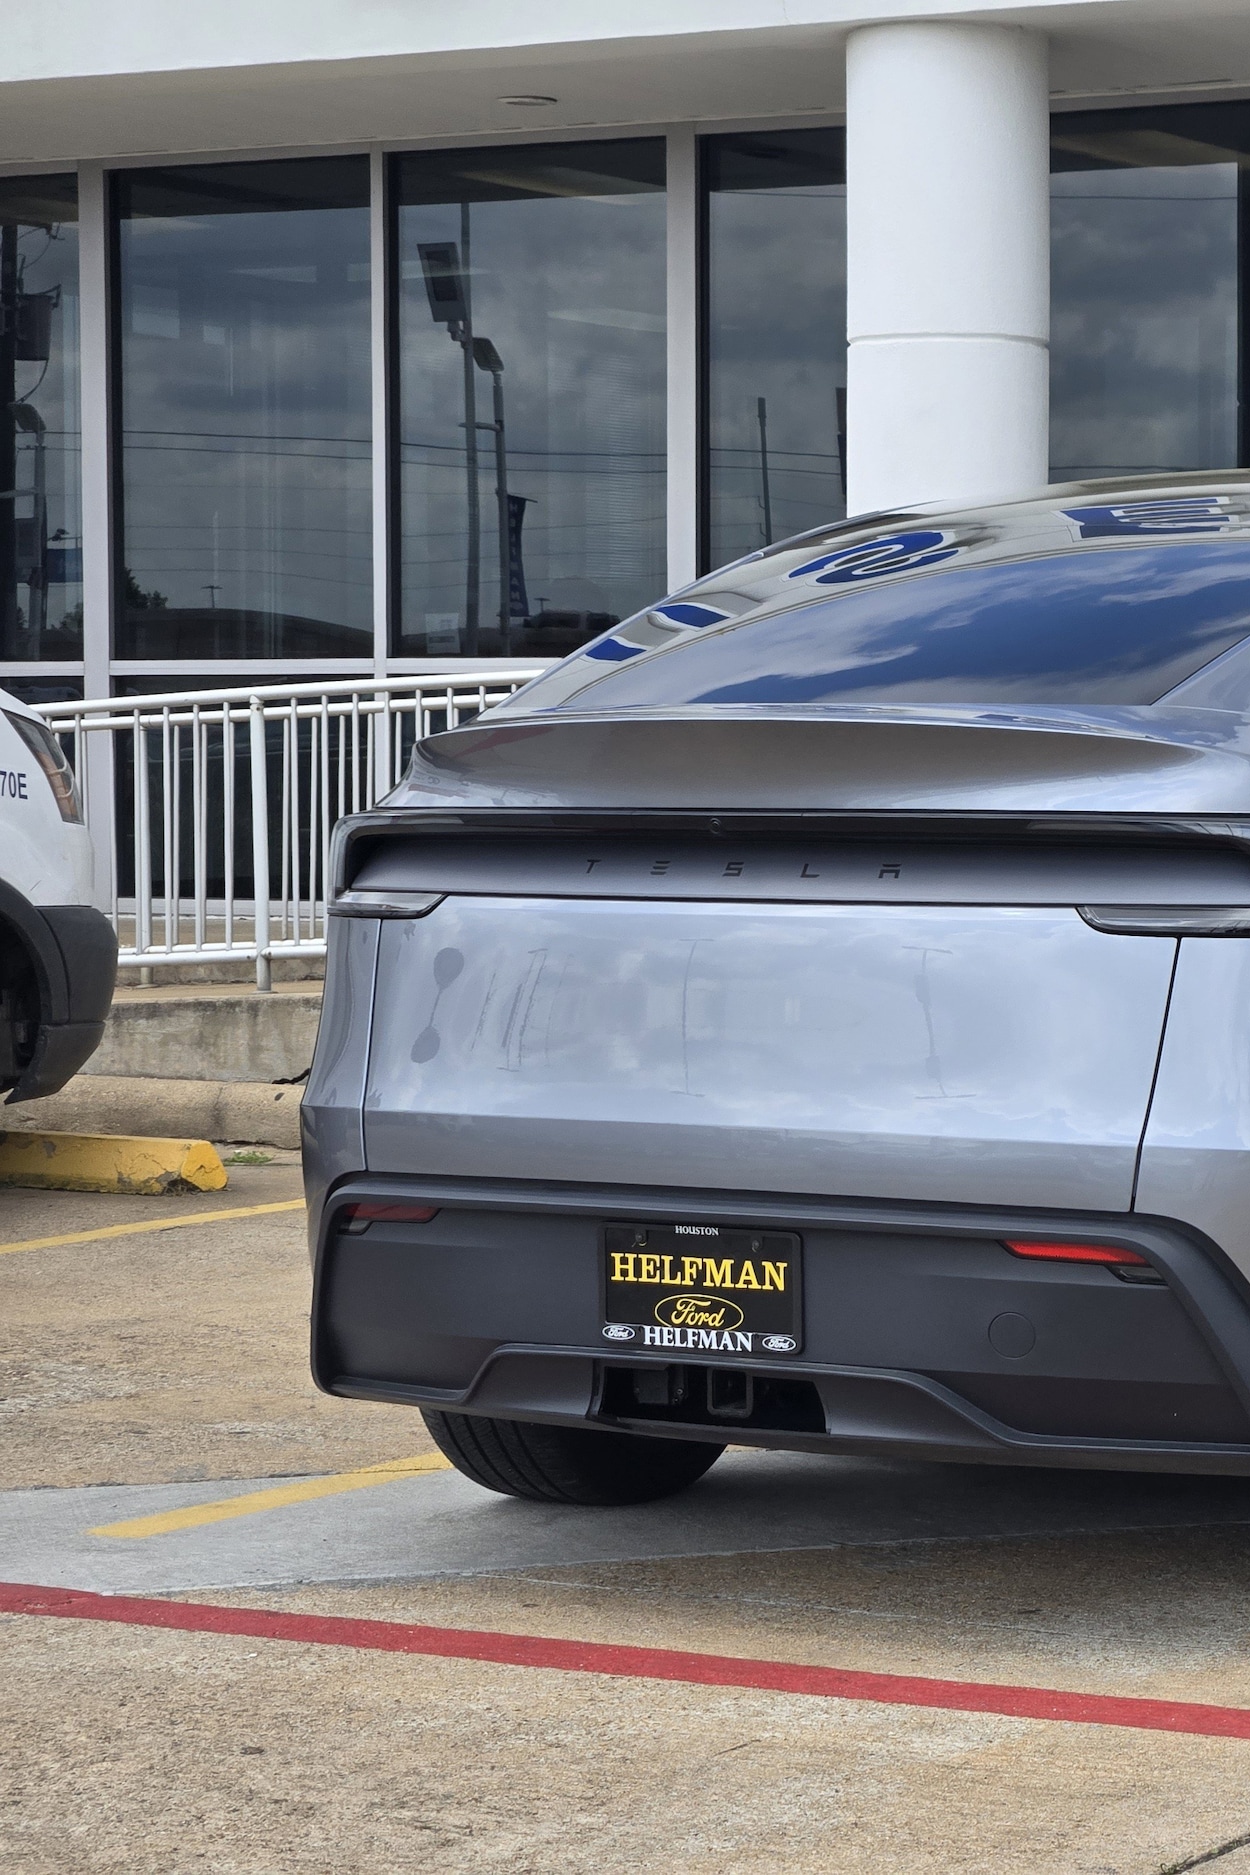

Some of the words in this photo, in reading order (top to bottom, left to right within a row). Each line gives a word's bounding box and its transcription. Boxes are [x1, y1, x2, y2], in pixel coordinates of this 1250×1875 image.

[586, 859, 902, 880] TESLA
[675, 1225, 719, 1236] HOUSTON
[610, 1252, 788, 1292] HELFMAN
[670, 1298, 726, 1327] Ford
[641, 1324, 753, 1352] HELFMAN
